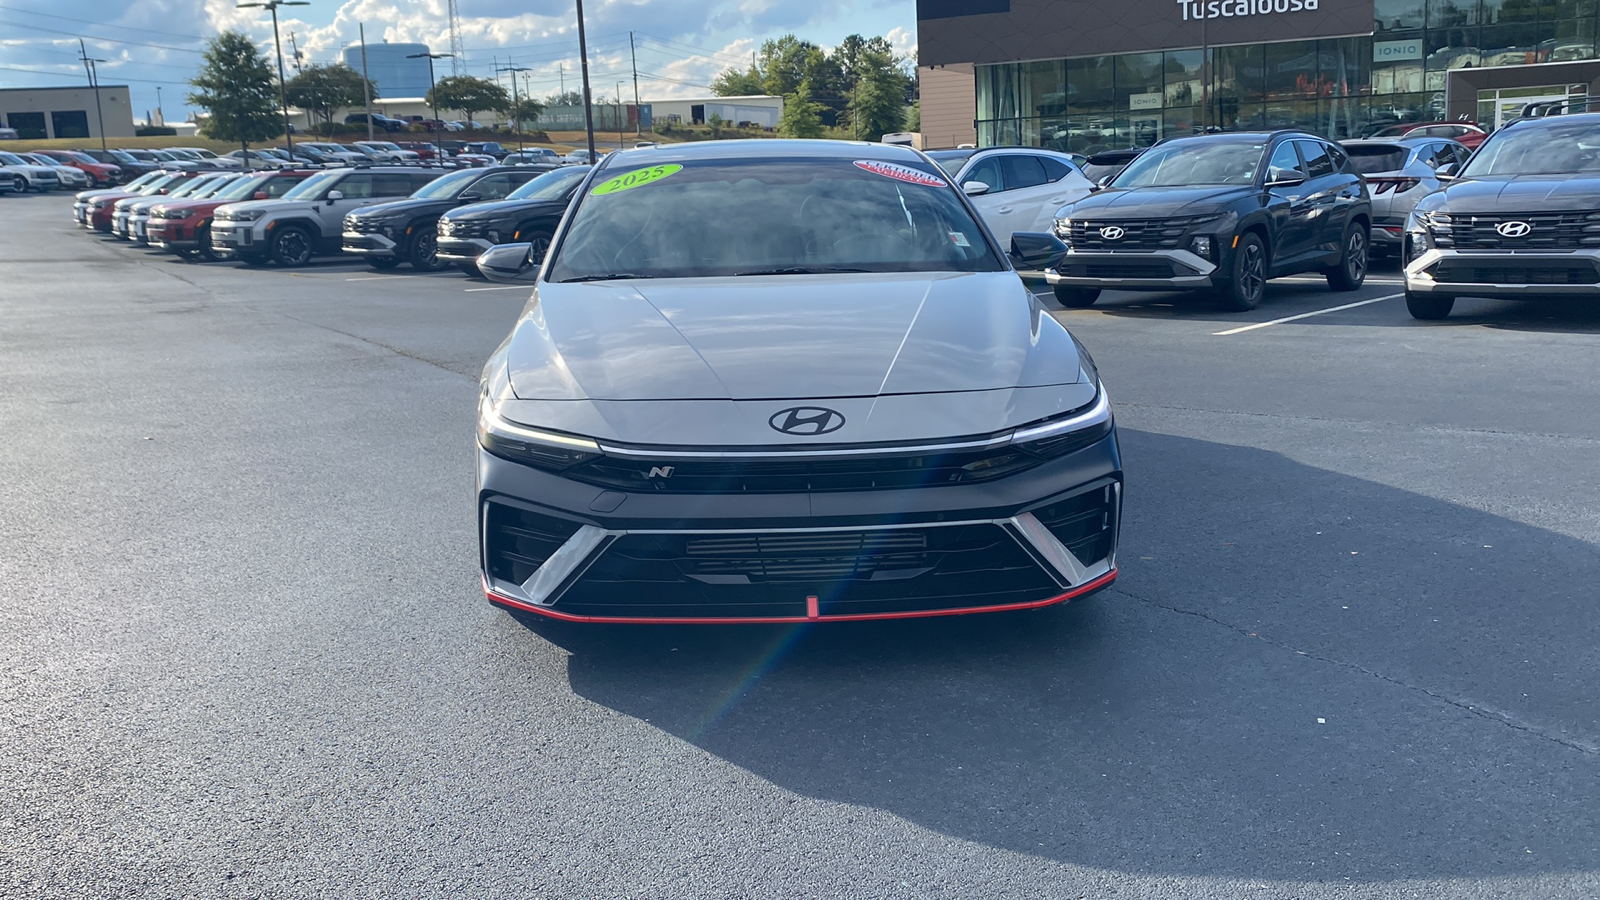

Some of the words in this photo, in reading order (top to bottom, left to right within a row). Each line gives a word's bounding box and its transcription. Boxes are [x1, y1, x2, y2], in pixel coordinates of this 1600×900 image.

[1177, 0, 1318, 20] Tuscaloosa
[608, 165, 665, 192] 2025
[866, 160, 938, 181] CERTIFIED
